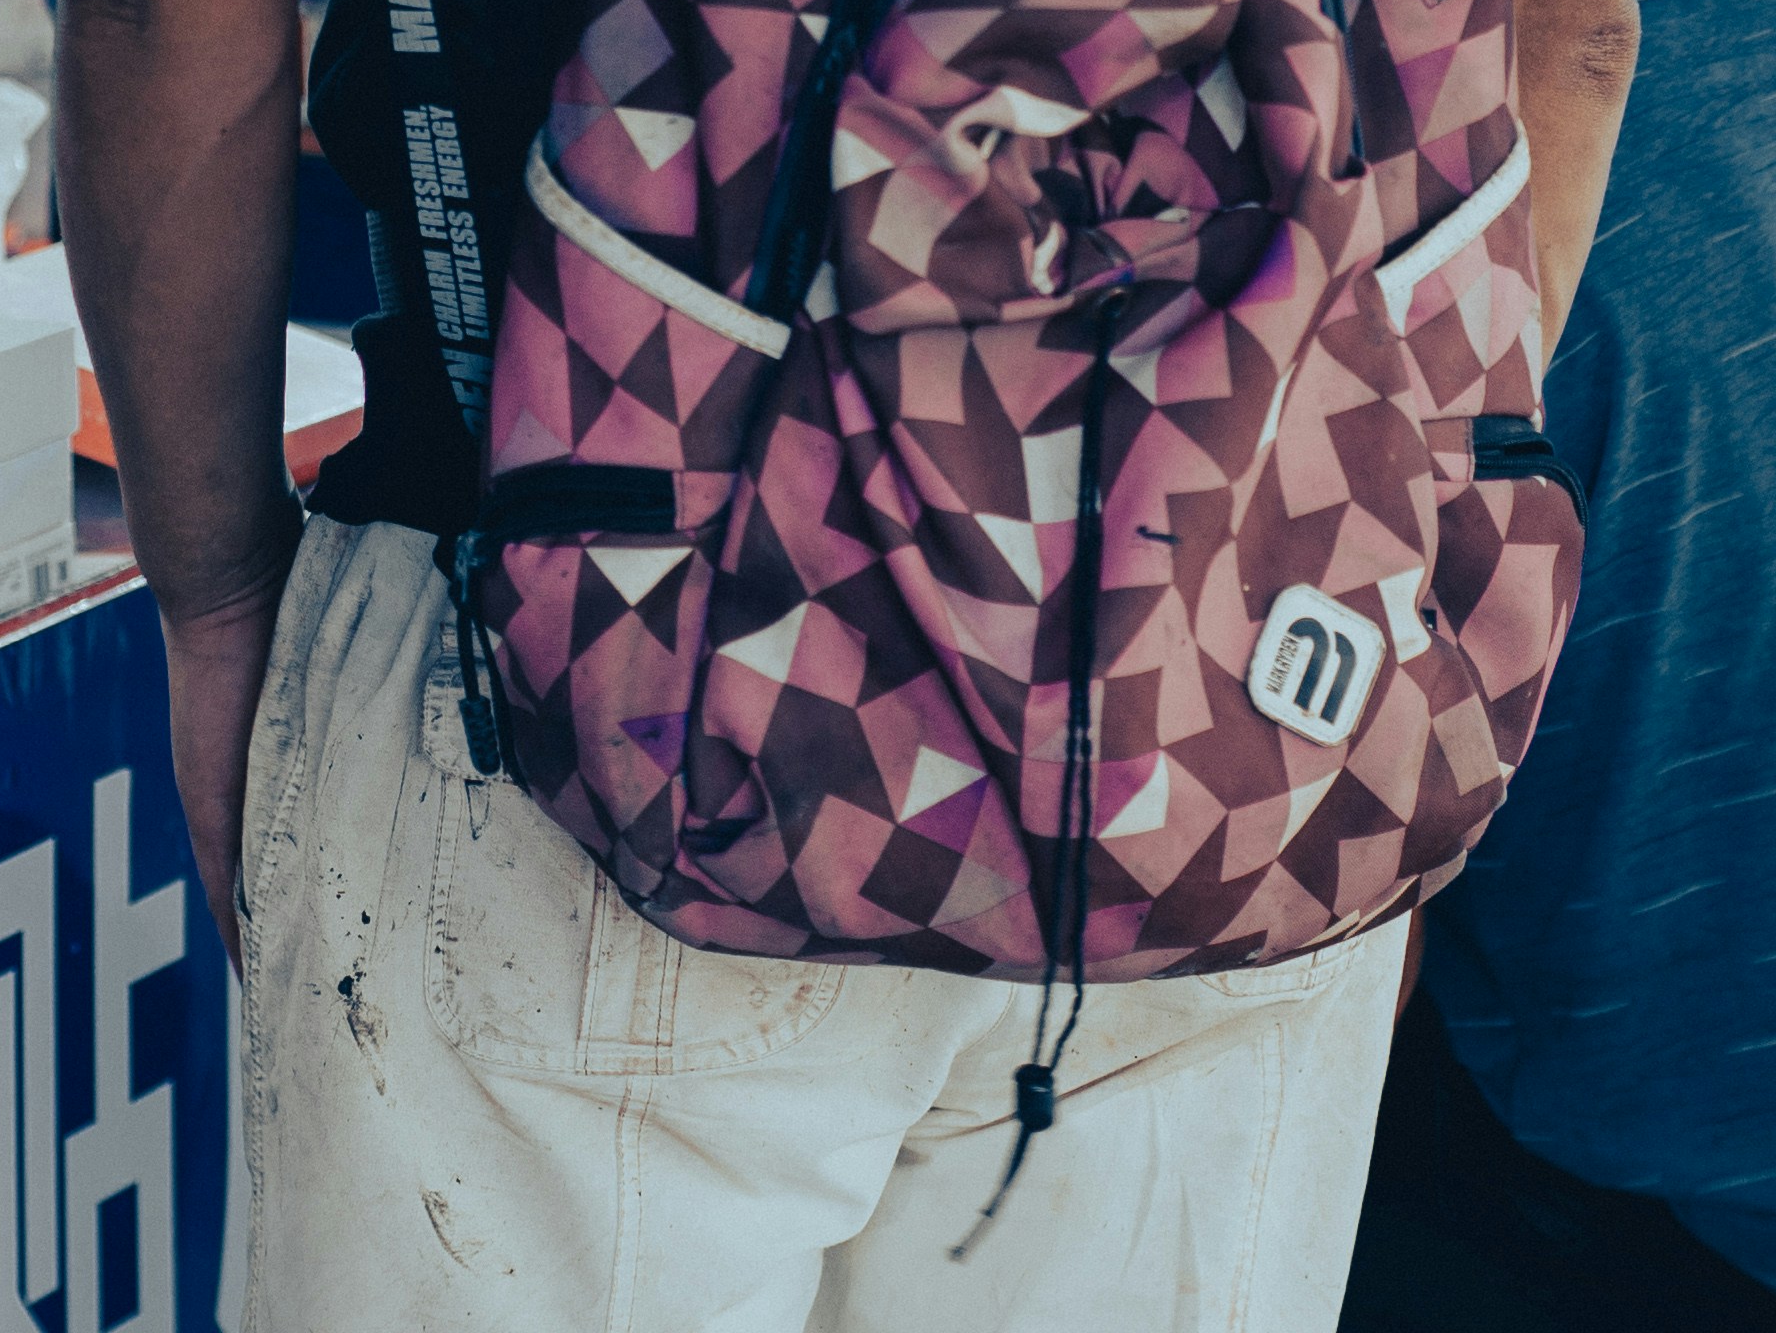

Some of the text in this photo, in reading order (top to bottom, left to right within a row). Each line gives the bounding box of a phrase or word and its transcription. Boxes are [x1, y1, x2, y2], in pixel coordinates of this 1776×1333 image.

[423, 250, 464, 342] CHARM
[429, 105, 490, 340] LIMITLESS ENERGY
